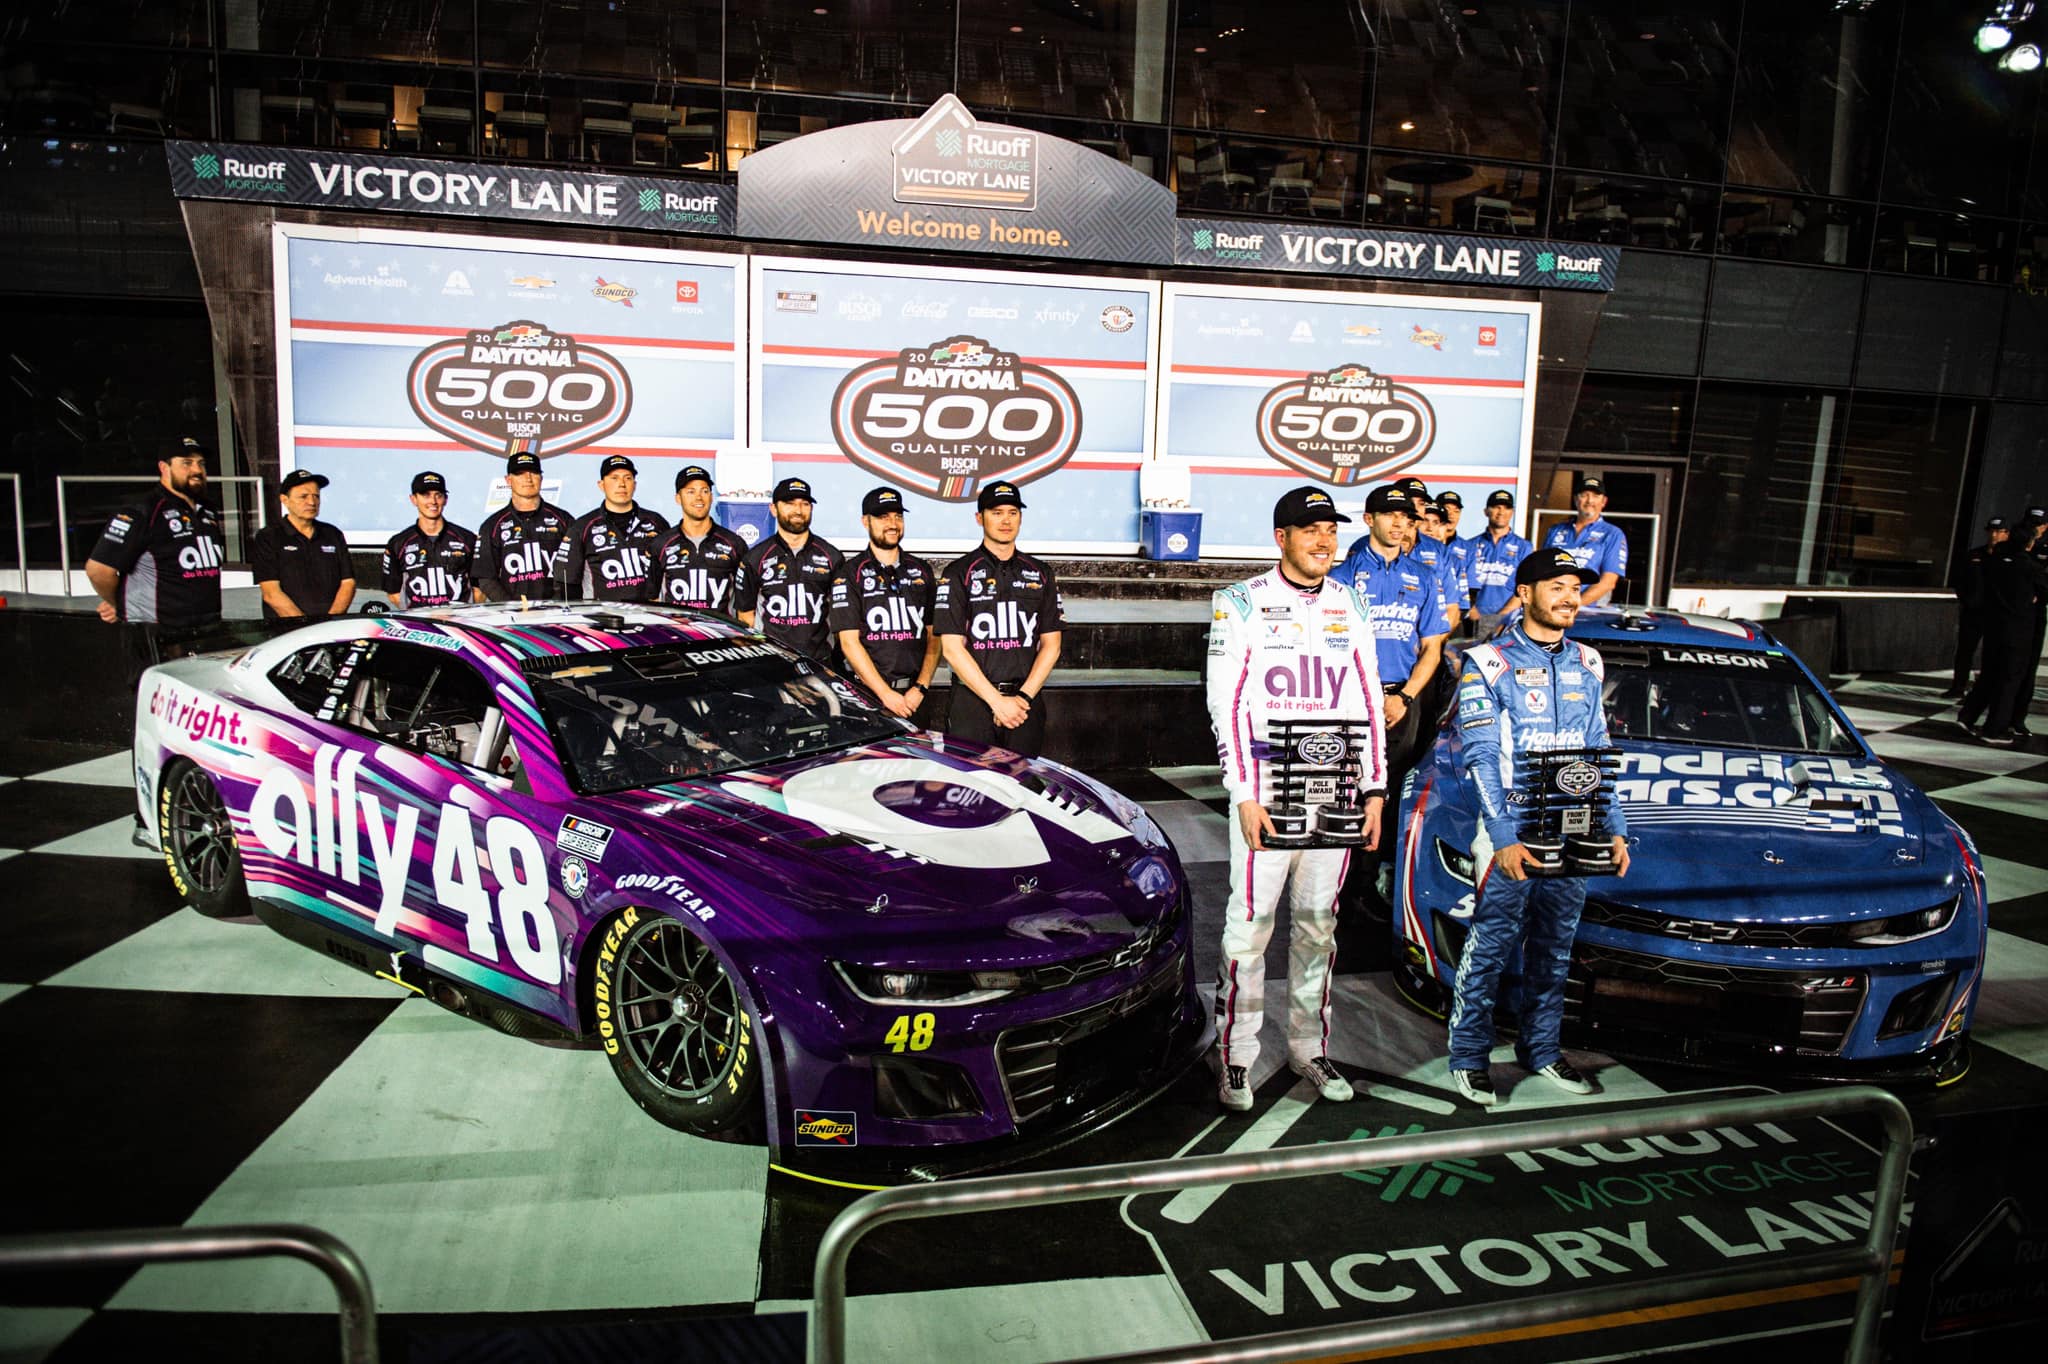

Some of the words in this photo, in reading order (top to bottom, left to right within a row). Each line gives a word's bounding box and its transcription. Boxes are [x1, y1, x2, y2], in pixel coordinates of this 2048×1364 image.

[967, 134, 1031, 157] Ruoff
[224, 159, 287, 179] Ruoff
[967, 158, 1031, 172] MORTGAGE
[224, 178, 287, 192] MORTGAGE
[310, 162, 498, 207] VICTORY
[511, 178, 618, 216] LANE
[901, 168, 979, 187] VICTORY
[984, 175, 1031, 190] LANE
[665, 192, 718, 213] Ruoff
[665, 212, 718, 225] MORTGAGE
[857, 210, 981, 240] Welcome
[990, 218, 1069, 247] home.
[1216, 233, 1264, 251] Ruoff
[1216, 249, 1263, 261] MORTGAGE
[1281, 233, 1426, 270] VICTORY
[1434, 244, 1521, 277] LANE
[1557, 255, 1601, 273] Ruoff
[323, 273, 408, 288] AdventHealth
[1557, 271, 1600, 283] MORTGAGE
[595, 287, 635, 298] SUNOCO
[1034, 306, 1080, 325] xfinity
[475, 334, 491, 343] 20
[554, 338, 567, 347] 23
[471, 346, 574, 367] DAYTONA
[909, 353, 926, 363] 20
[996, 357, 1012, 366] 23
[903, 367, 1018, 390] DAYTONA
[1313, 376, 1326, 385] 20
[435, 368, 606, 410] 500
[1308, 386, 1391, 404] DAYTONA
[461, 410, 583, 423] QUALIFYING
[863, 393, 1053, 442] 500
[1278, 405, 1416, 443] 500
[507, 422, 540, 434] BUSCH
[891, 442, 1026, 457] QUALIFYING
[1297, 442, 1395, 453] QUALIFYING
[941, 457, 978, 470] BUSCH
[1332, 453, 1360, 463] BUSCH
[504, 542, 557, 578] ally
[409, 567, 463, 600] ally
[606, 579, 617, 588] do
[617, 578, 625, 587] it
[670, 569, 728, 609] ally
[766, 583, 824, 624] ally
[1370, 602, 1418, 622] endrick
[867, 597, 924, 639] ally
[971, 601, 1038, 647] ally
[1372, 620, 1413, 634] ars.com
[407, 630, 463, 650] BOWMAN
[867, 633, 880, 641] do
[881, 631, 889, 640] it
[890, 631, 914, 641] right.
[973, 640, 985, 650] do
[987, 639, 994, 649] it
[996, 639, 1021, 650] right.
[686, 643, 781, 665] BOWMAN
[1663, 650, 1769, 669] LARSON
[1265, 655, 1348, 709] ally
[150, 683, 164, 716] do
[164, 688, 178, 726] it
[179, 697, 248, 746] right.
[1266, 700, 1281, 710] do
[1284, 700, 1292, 710] it
[1296, 701, 1326, 712] right.
[1305, 743, 1339, 754] 500
[1563, 773, 1595, 783] 500
[1611, 750, 1892, 790] ndrick
[1308, 787, 1333, 795] AWARD
[1617, 779, 1900, 812] ars.com
[249, 742, 421, 938] ally
[432, 802, 562, 985] 48
[615, 874, 717, 922] GOODYEAR
[596, 906, 640, 1055] GOODYEAR
[884, 1012, 936, 1053] 48
[728, 1009, 750, 1094] EAGLE
[800, 1124, 851, 1134] SUNOCO
[1542, 1151, 1871, 1213] MORTGAGE
[1210, 1221, 1669, 1316] VICTORY
